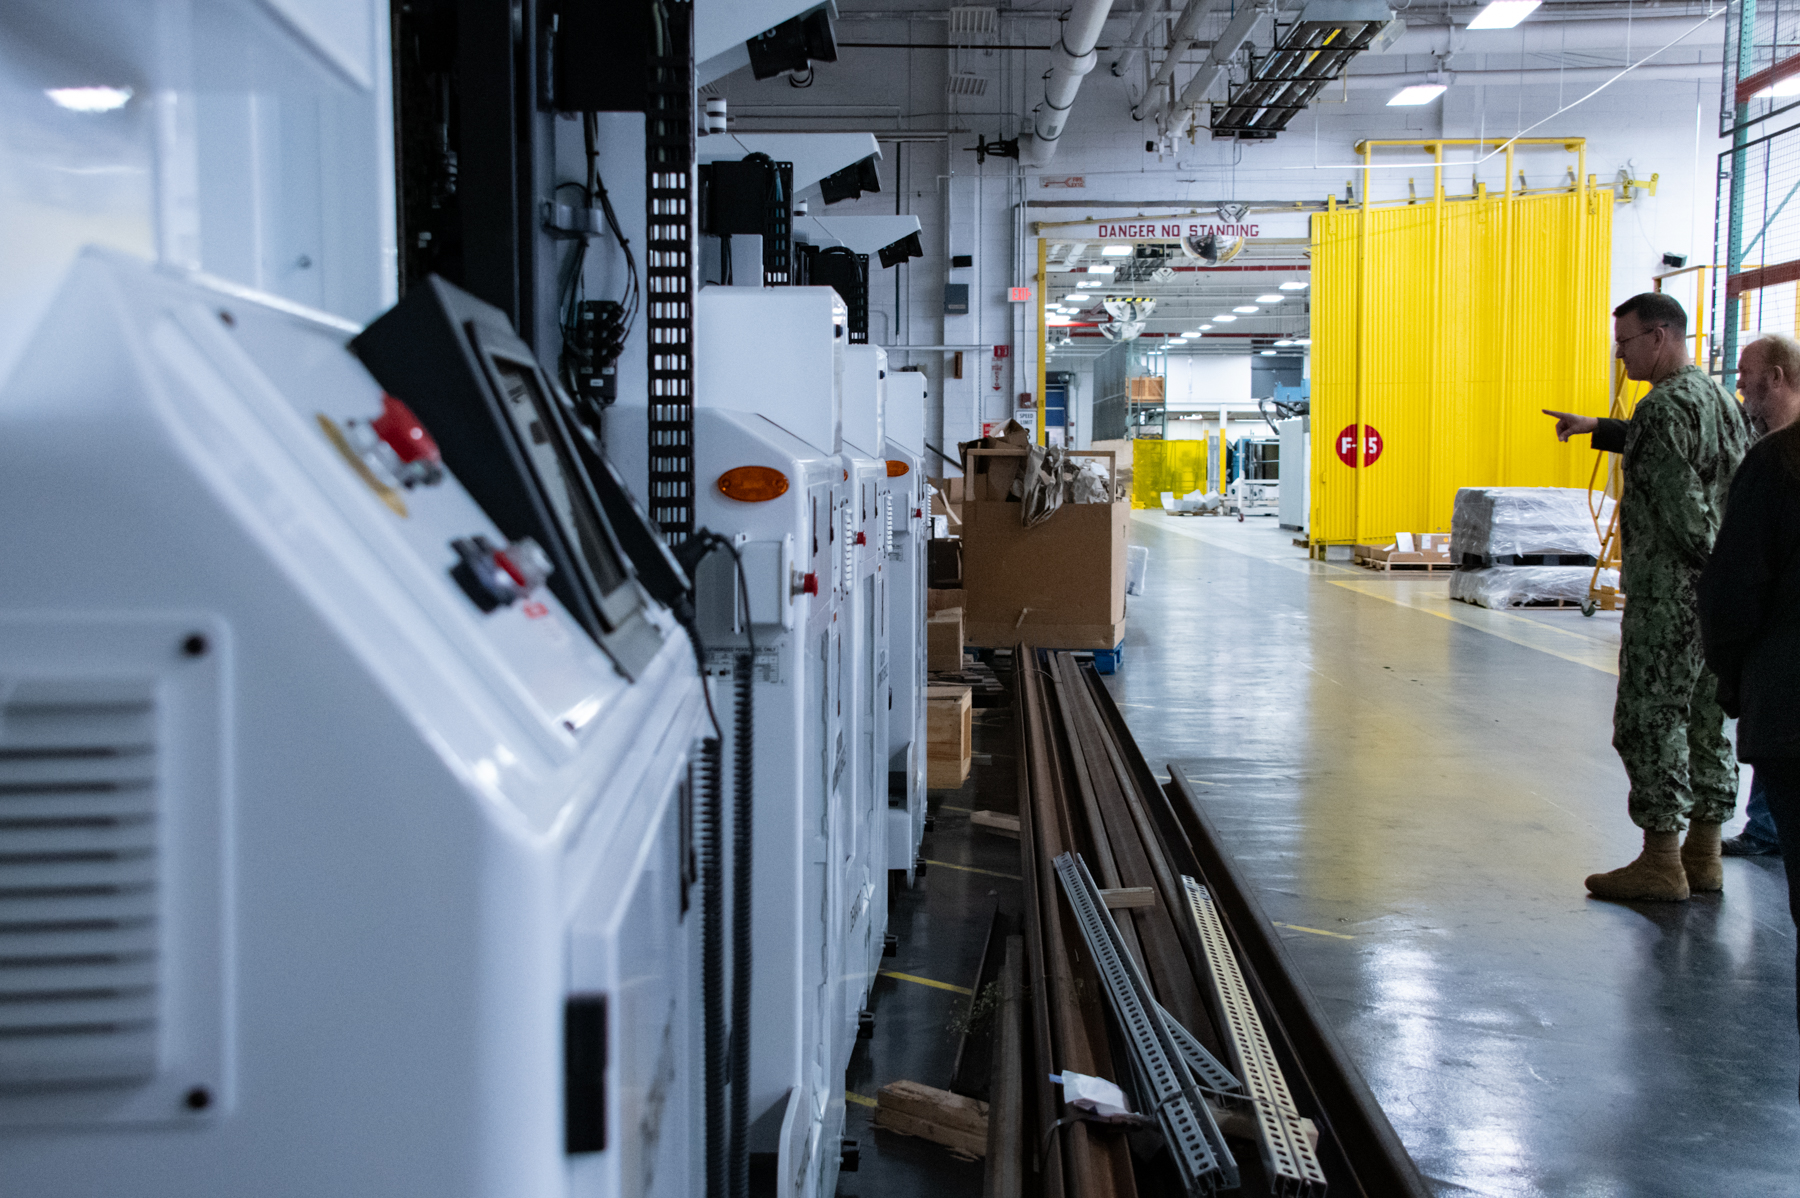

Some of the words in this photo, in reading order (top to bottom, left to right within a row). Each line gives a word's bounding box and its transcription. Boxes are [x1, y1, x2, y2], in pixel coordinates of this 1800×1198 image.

[1098, 224, 1156, 238] DANGER
[1161, 224, 1180, 237] NO
[1189, 224, 1260, 237] STANDING
[1012, 287, 1029, 301] EXIT
